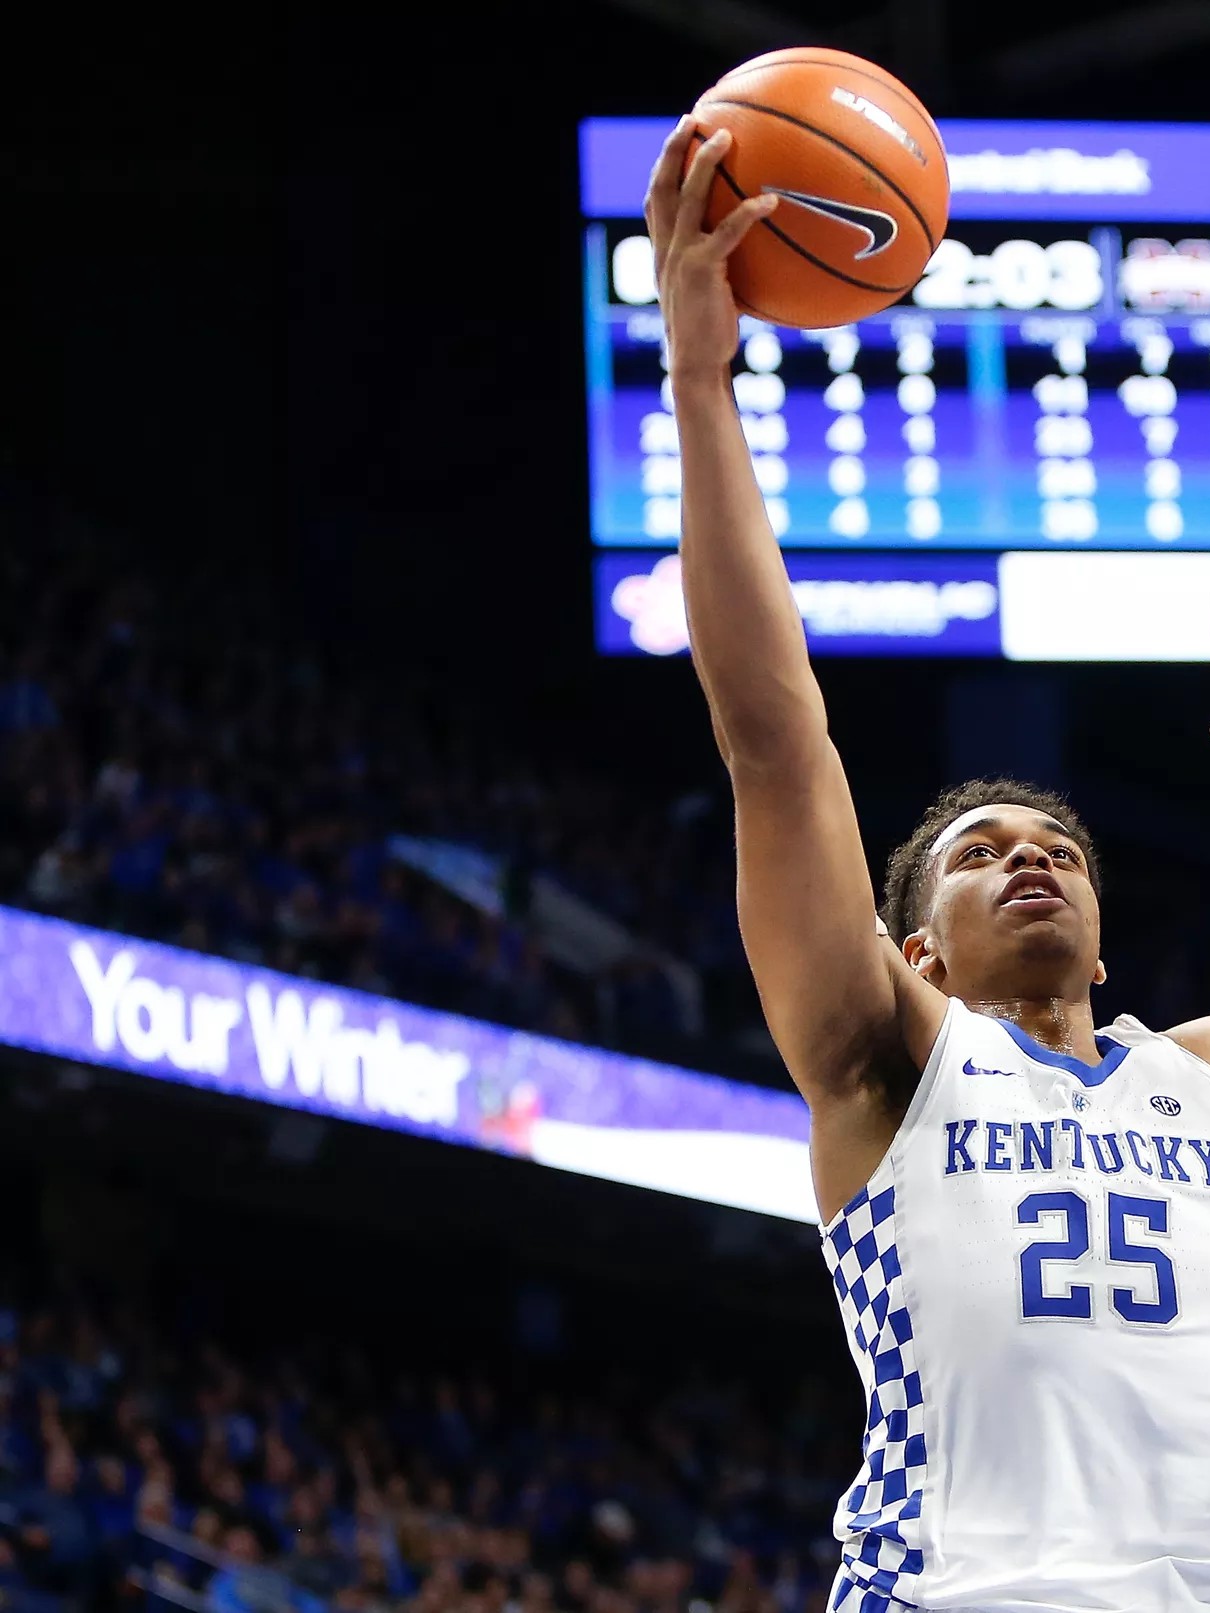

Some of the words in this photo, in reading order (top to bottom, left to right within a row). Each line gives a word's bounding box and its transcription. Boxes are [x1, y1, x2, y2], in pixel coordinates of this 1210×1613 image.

[69, 940, 243, 1075] Your
[245, 981, 471, 1127] Winter
[1151, 1096, 1181, 1116] SEC
[1013, 1188, 1181, 1329] 25
